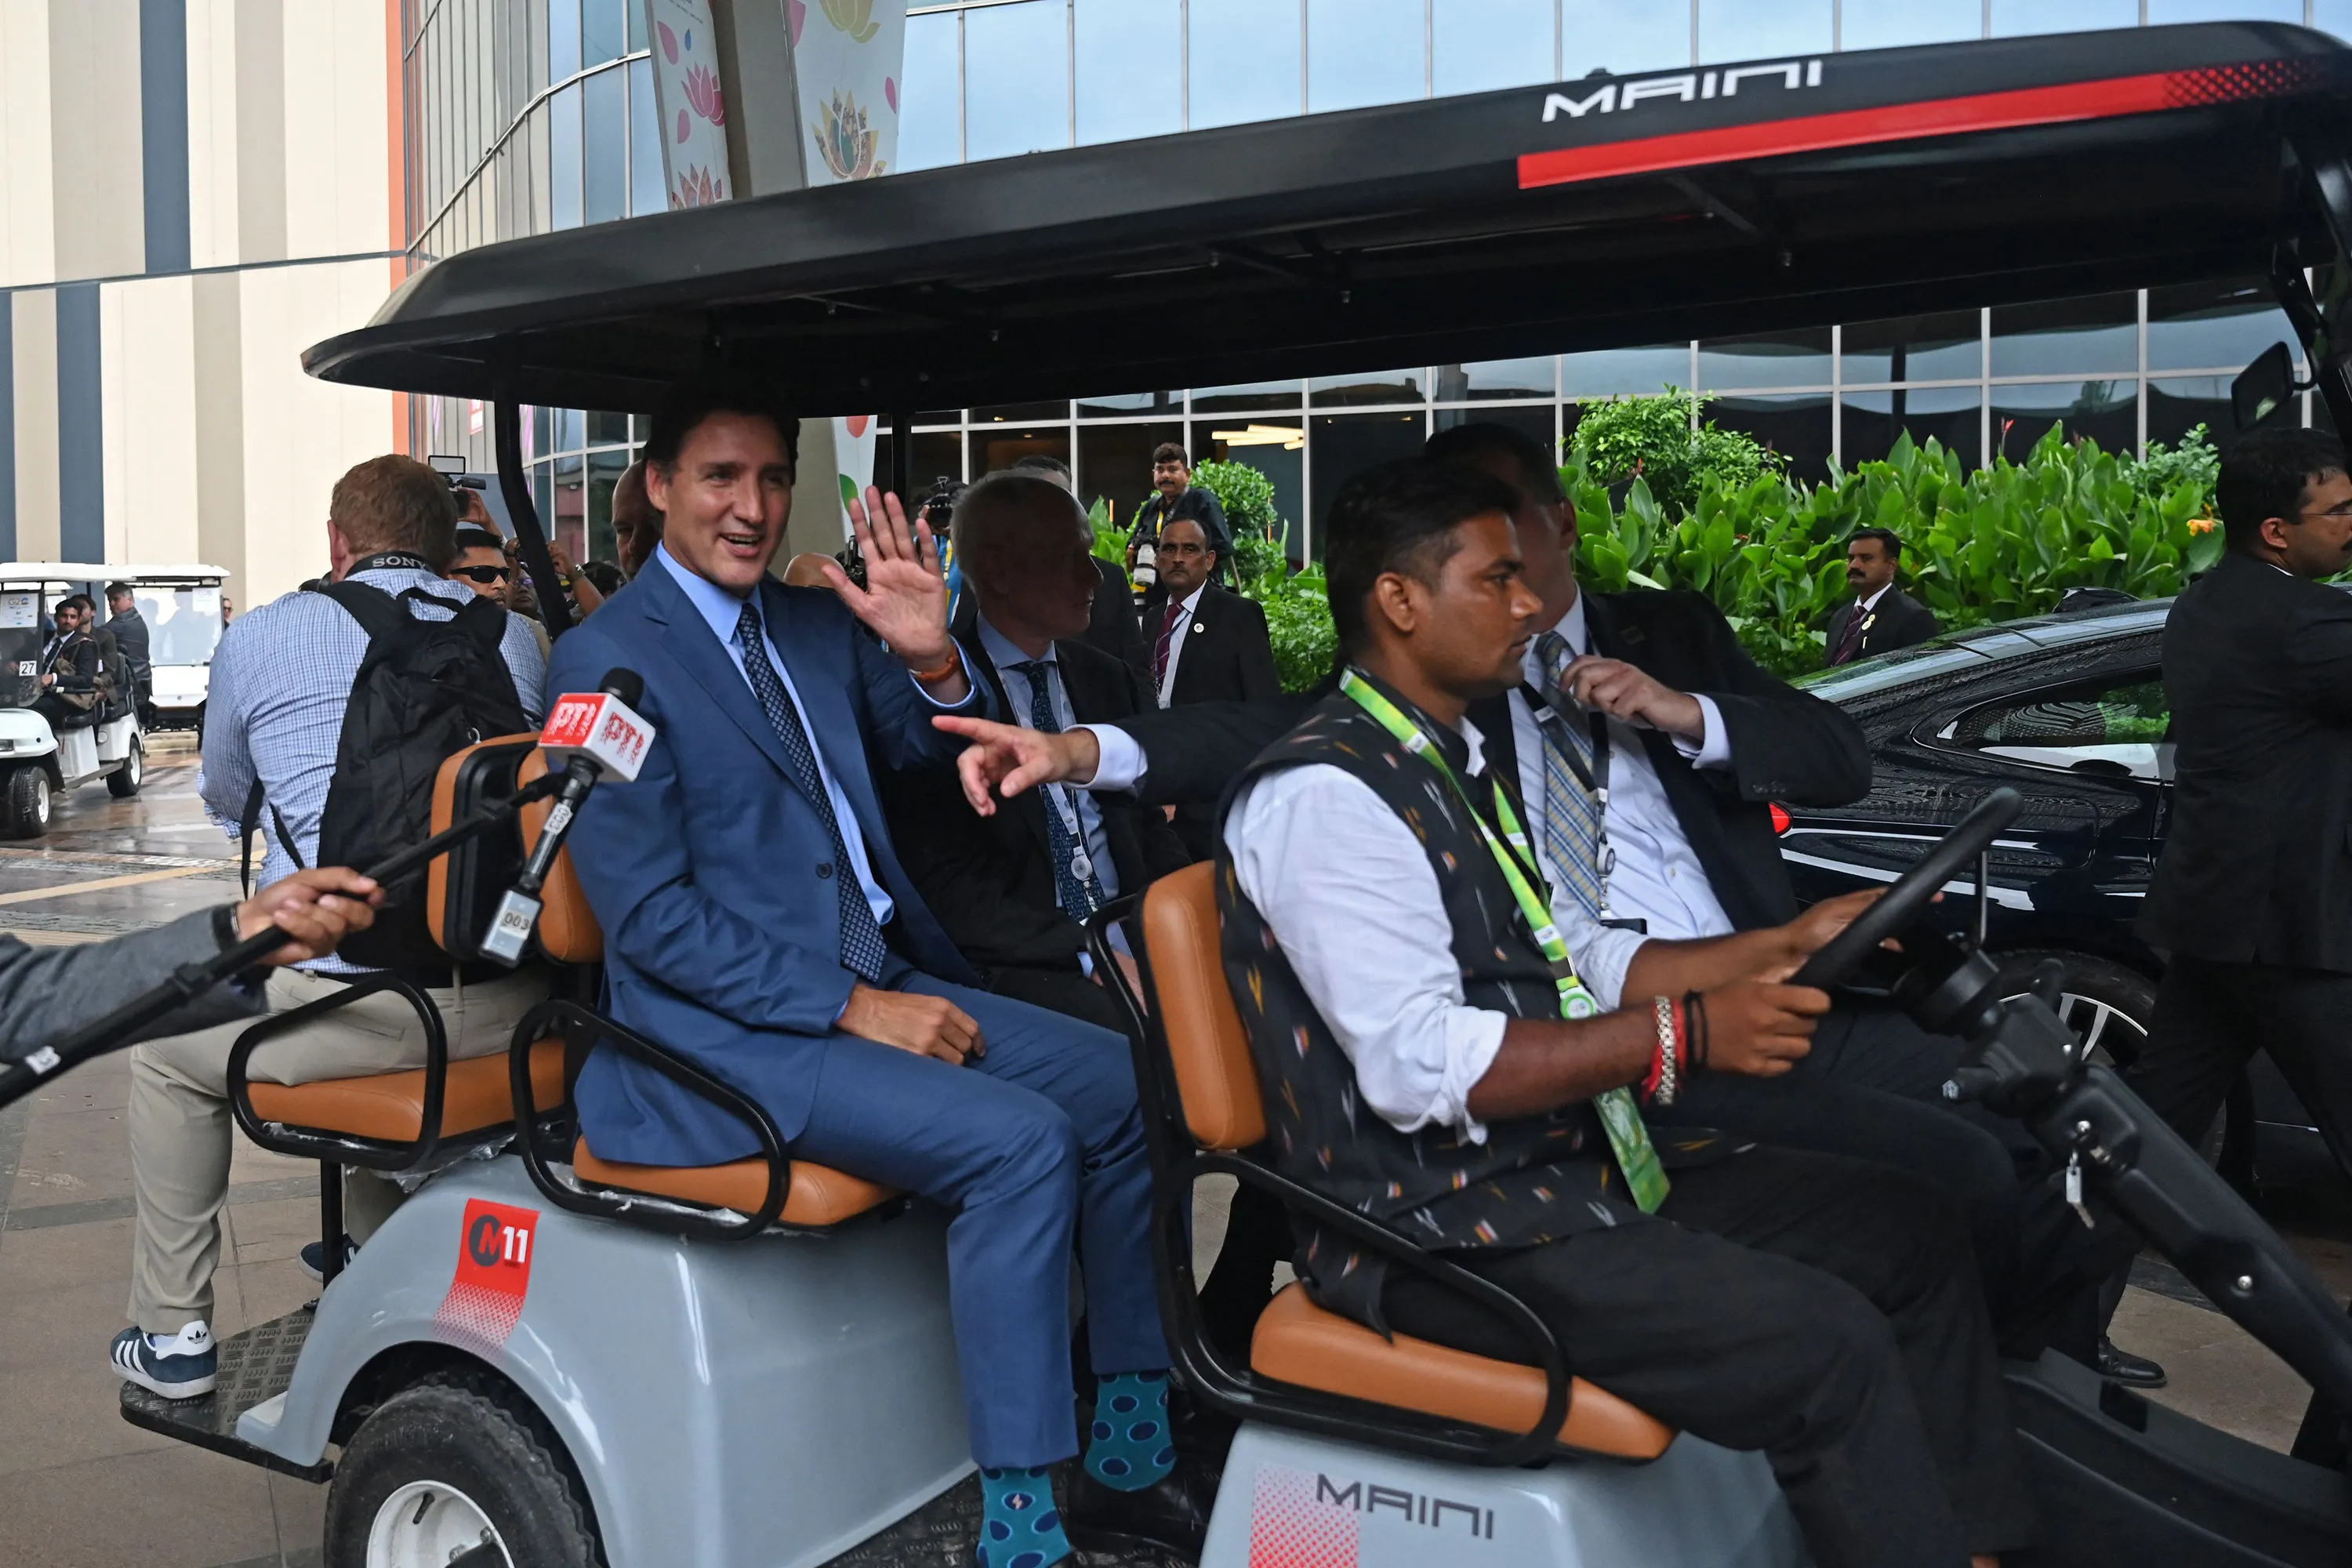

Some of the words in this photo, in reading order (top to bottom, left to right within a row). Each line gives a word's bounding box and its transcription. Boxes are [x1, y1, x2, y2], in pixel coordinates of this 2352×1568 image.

[1541, 60, 1822, 122] MAINI
[372, 556, 425, 568] SONY
[21, 662, 35, 674] 27
[547, 702, 597, 737] PTI
[600, 711, 644, 766] PTI
[504, 913, 530, 931] 003
[1316, 1473, 1494, 1540] MAINI
